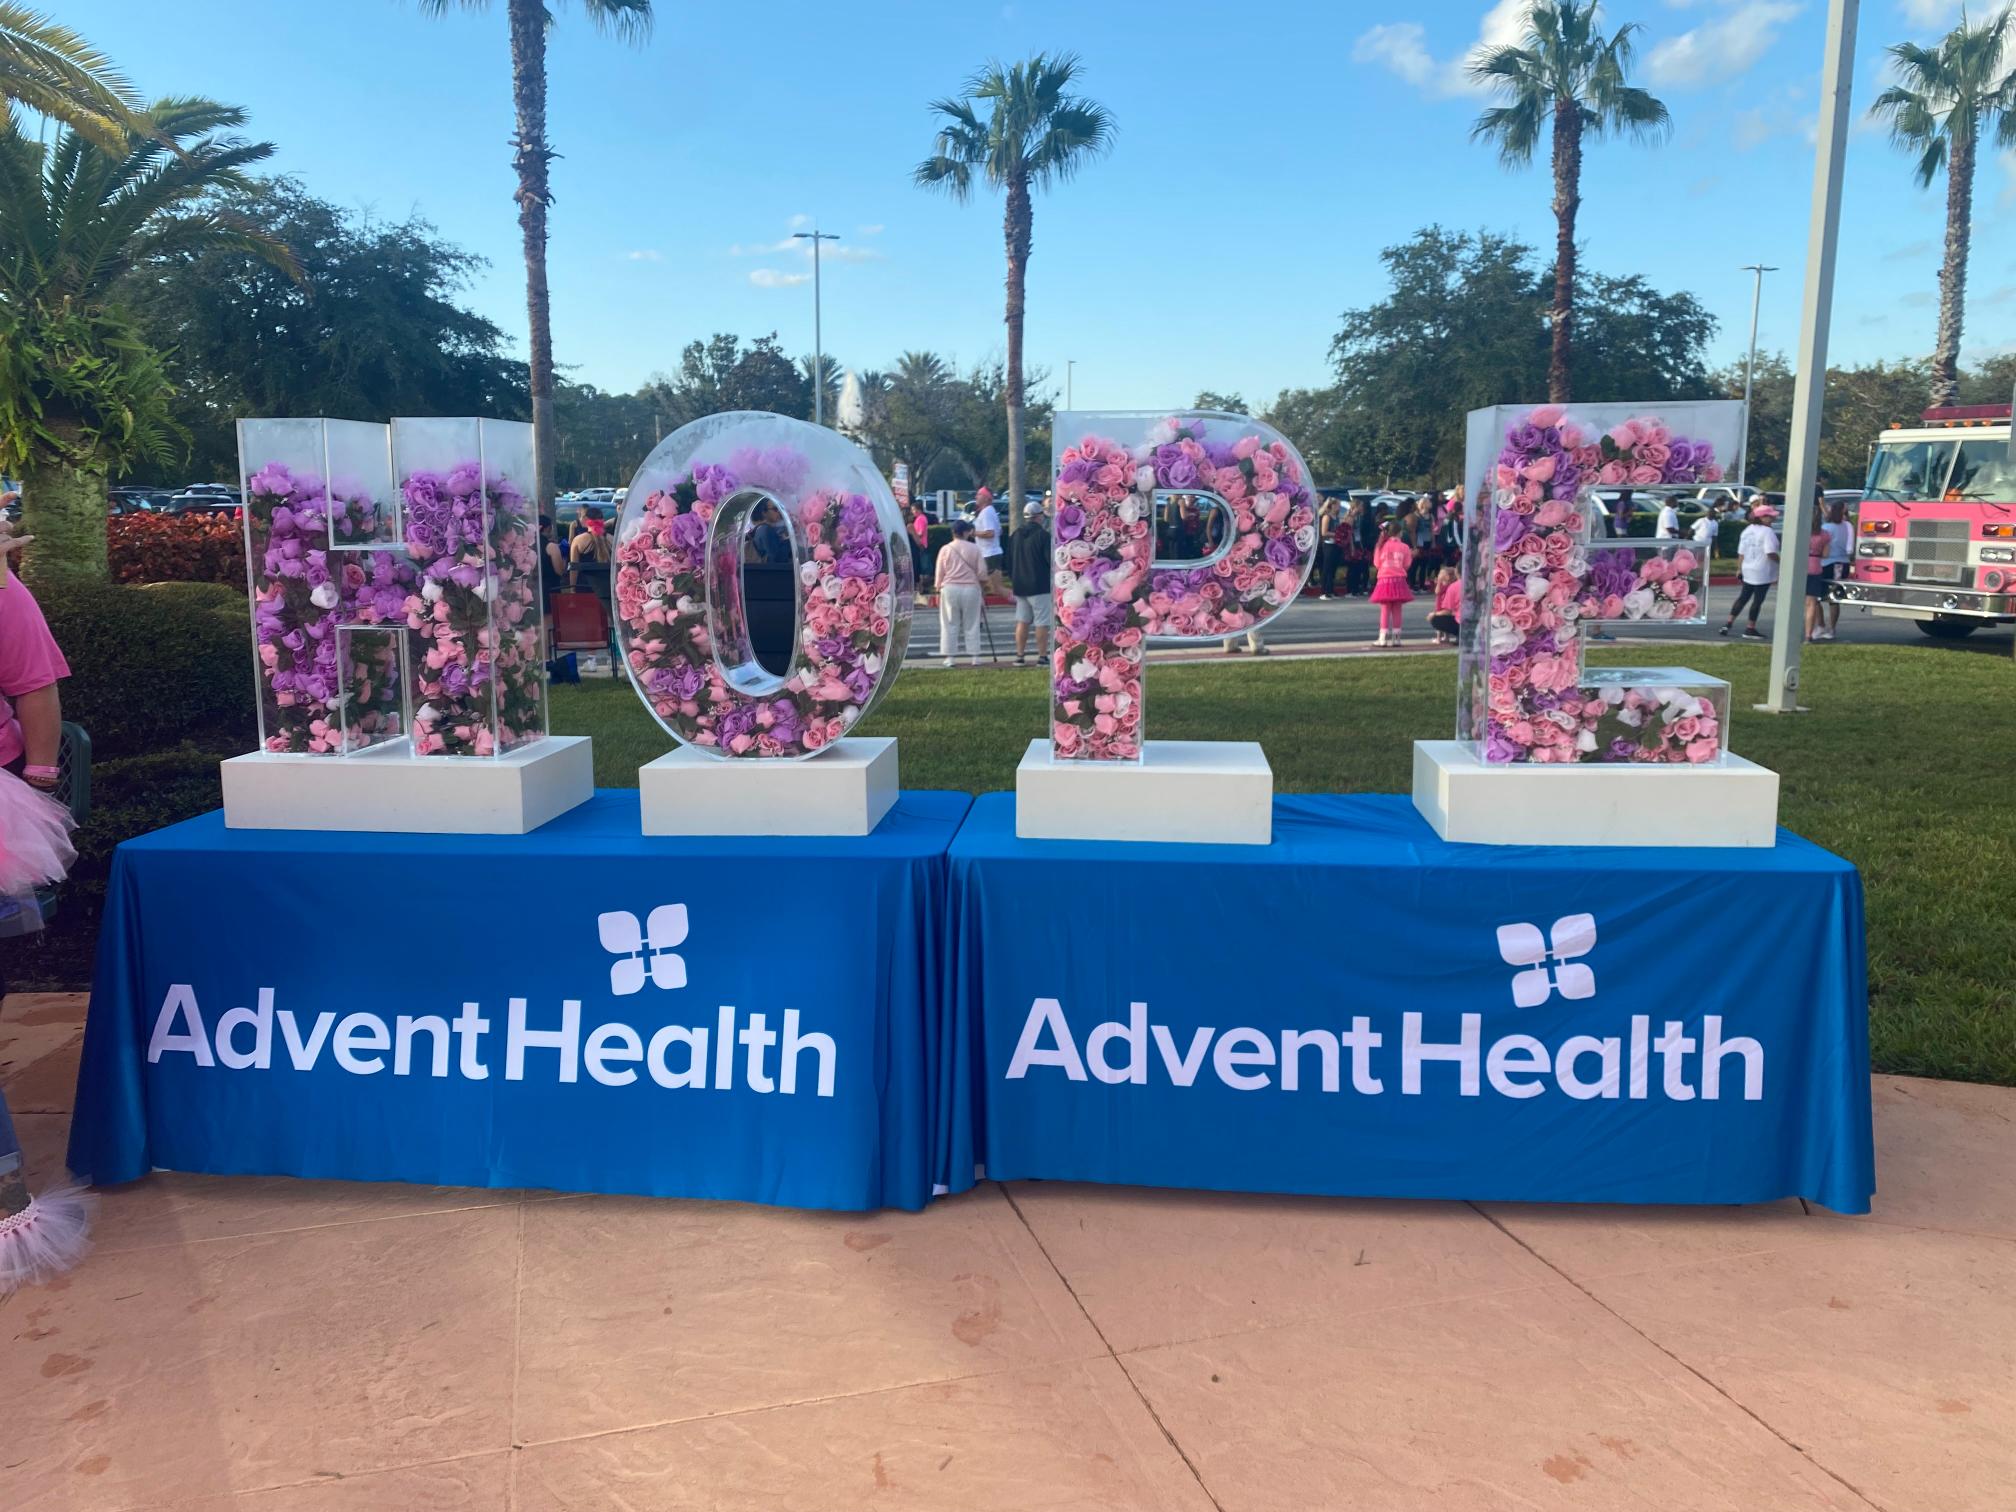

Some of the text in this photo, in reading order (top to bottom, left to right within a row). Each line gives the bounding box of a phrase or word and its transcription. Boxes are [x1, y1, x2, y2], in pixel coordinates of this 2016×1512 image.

[237, 402, 1747, 766] HOPE
[147, 983, 838, 1097] AdventHealth
[1006, 997, 1765, 1101] AdventHealth
